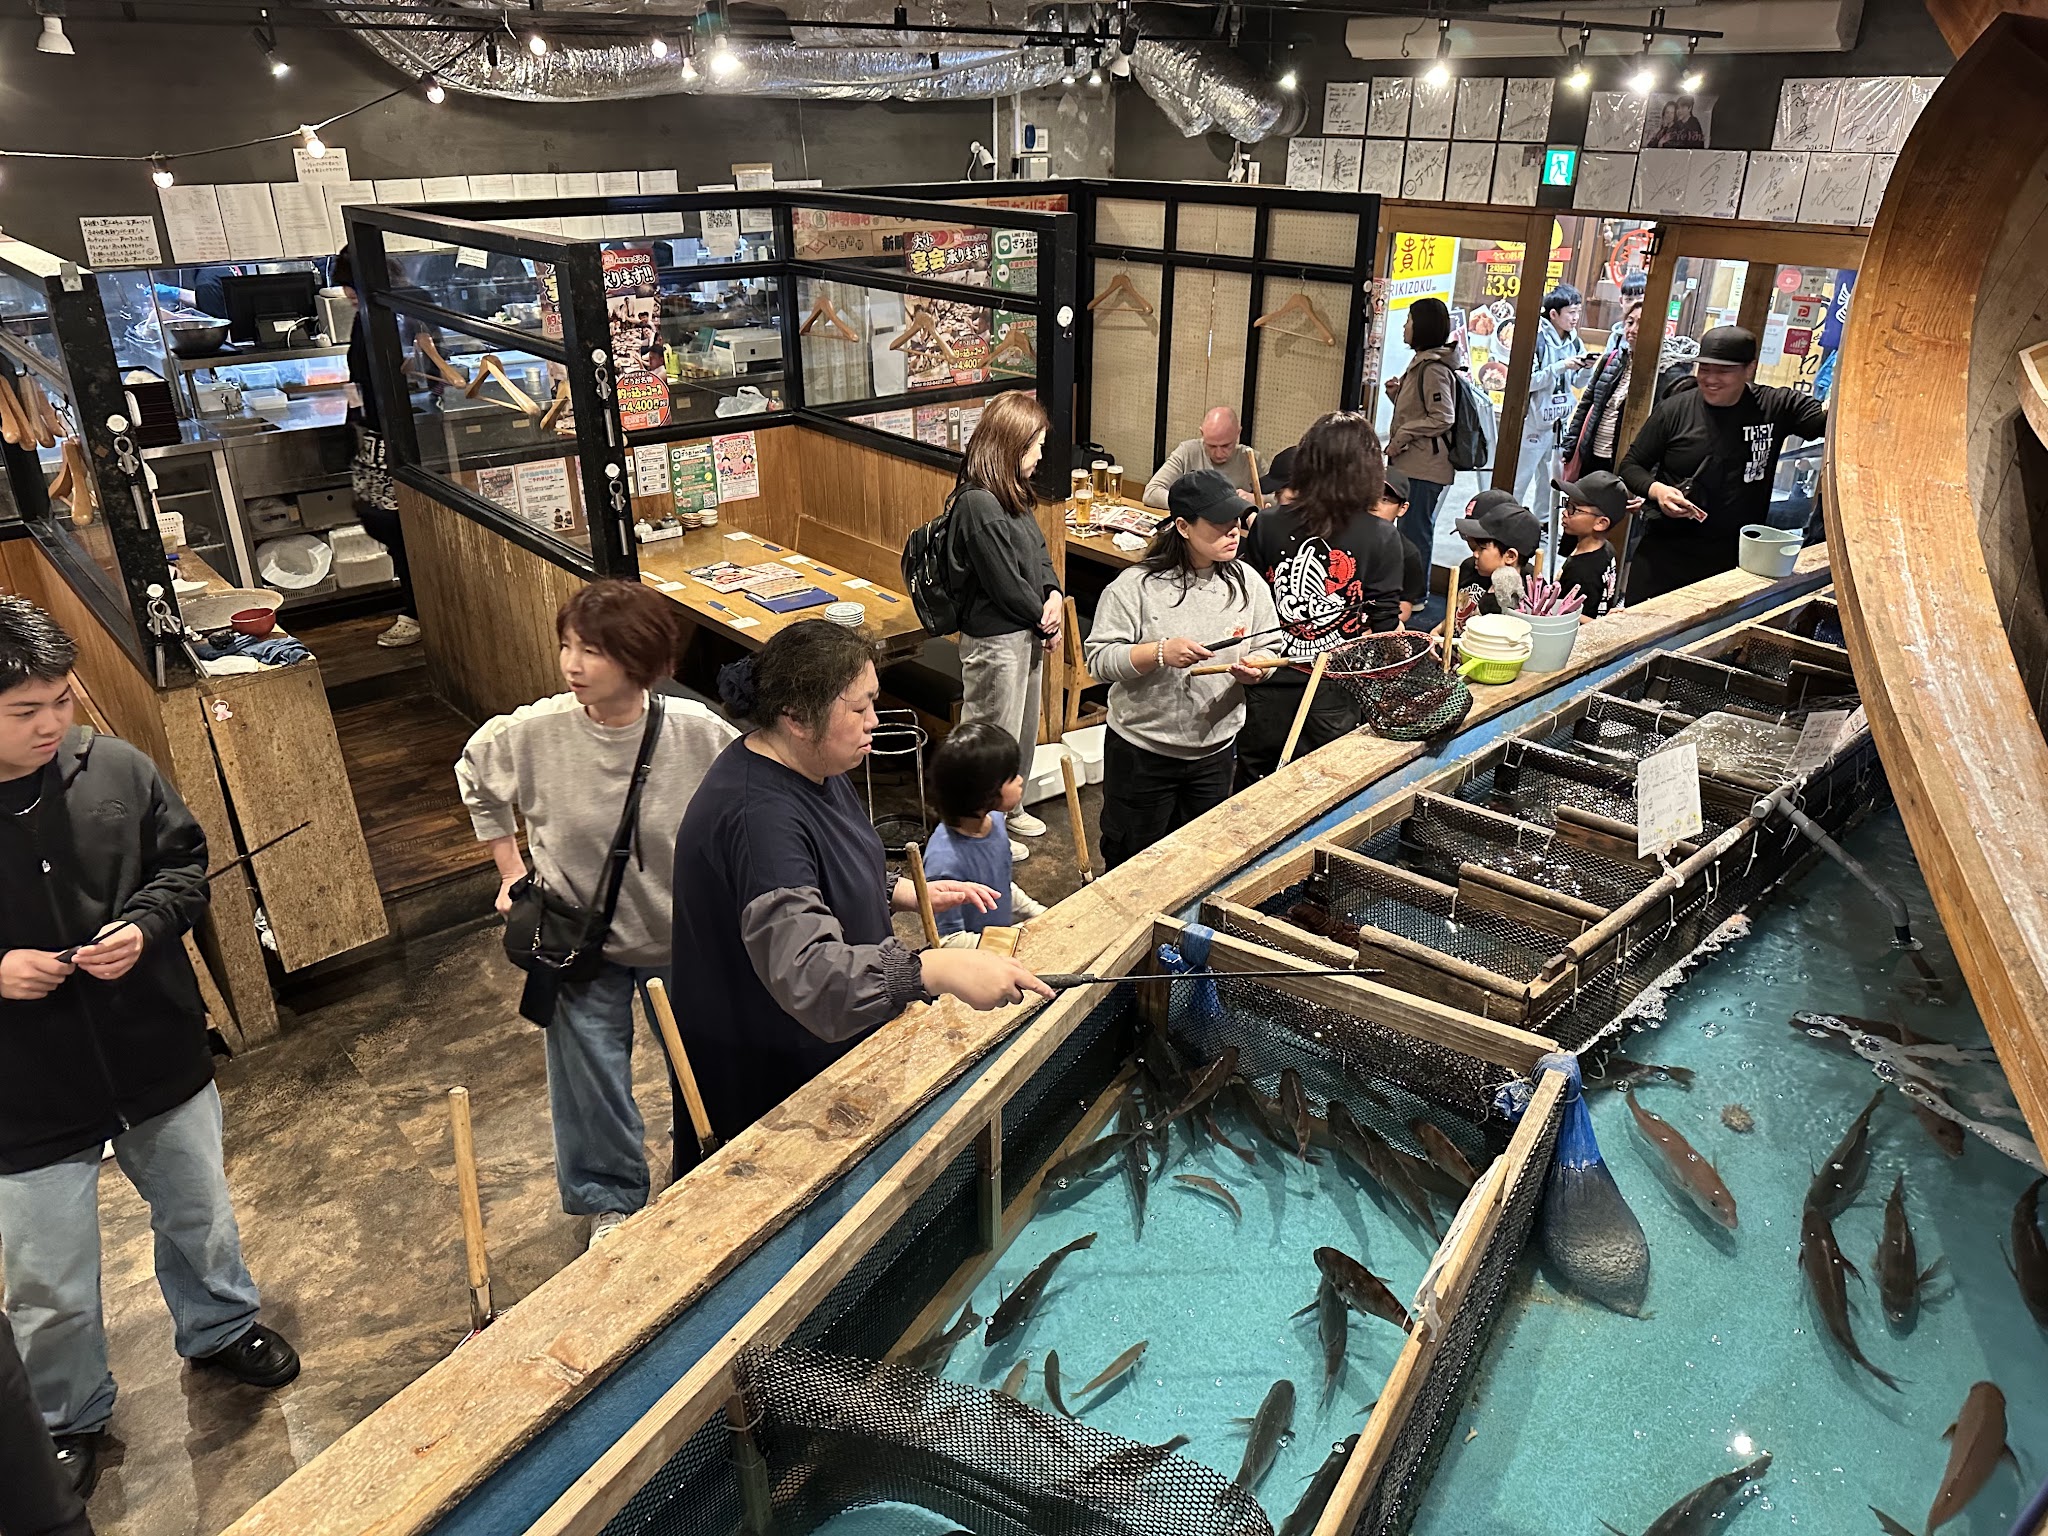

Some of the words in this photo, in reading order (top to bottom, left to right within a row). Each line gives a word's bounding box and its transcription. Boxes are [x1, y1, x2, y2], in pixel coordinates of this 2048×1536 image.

[1389, 279, 1433, 297] RIKIZOKU
[1491, 275, 1521, 299] 3,9
[1792, 316, 1811, 325] PayPay
[949, 409, 959, 418] 60
[1292, 629, 1342, 649] RESTAURANT
